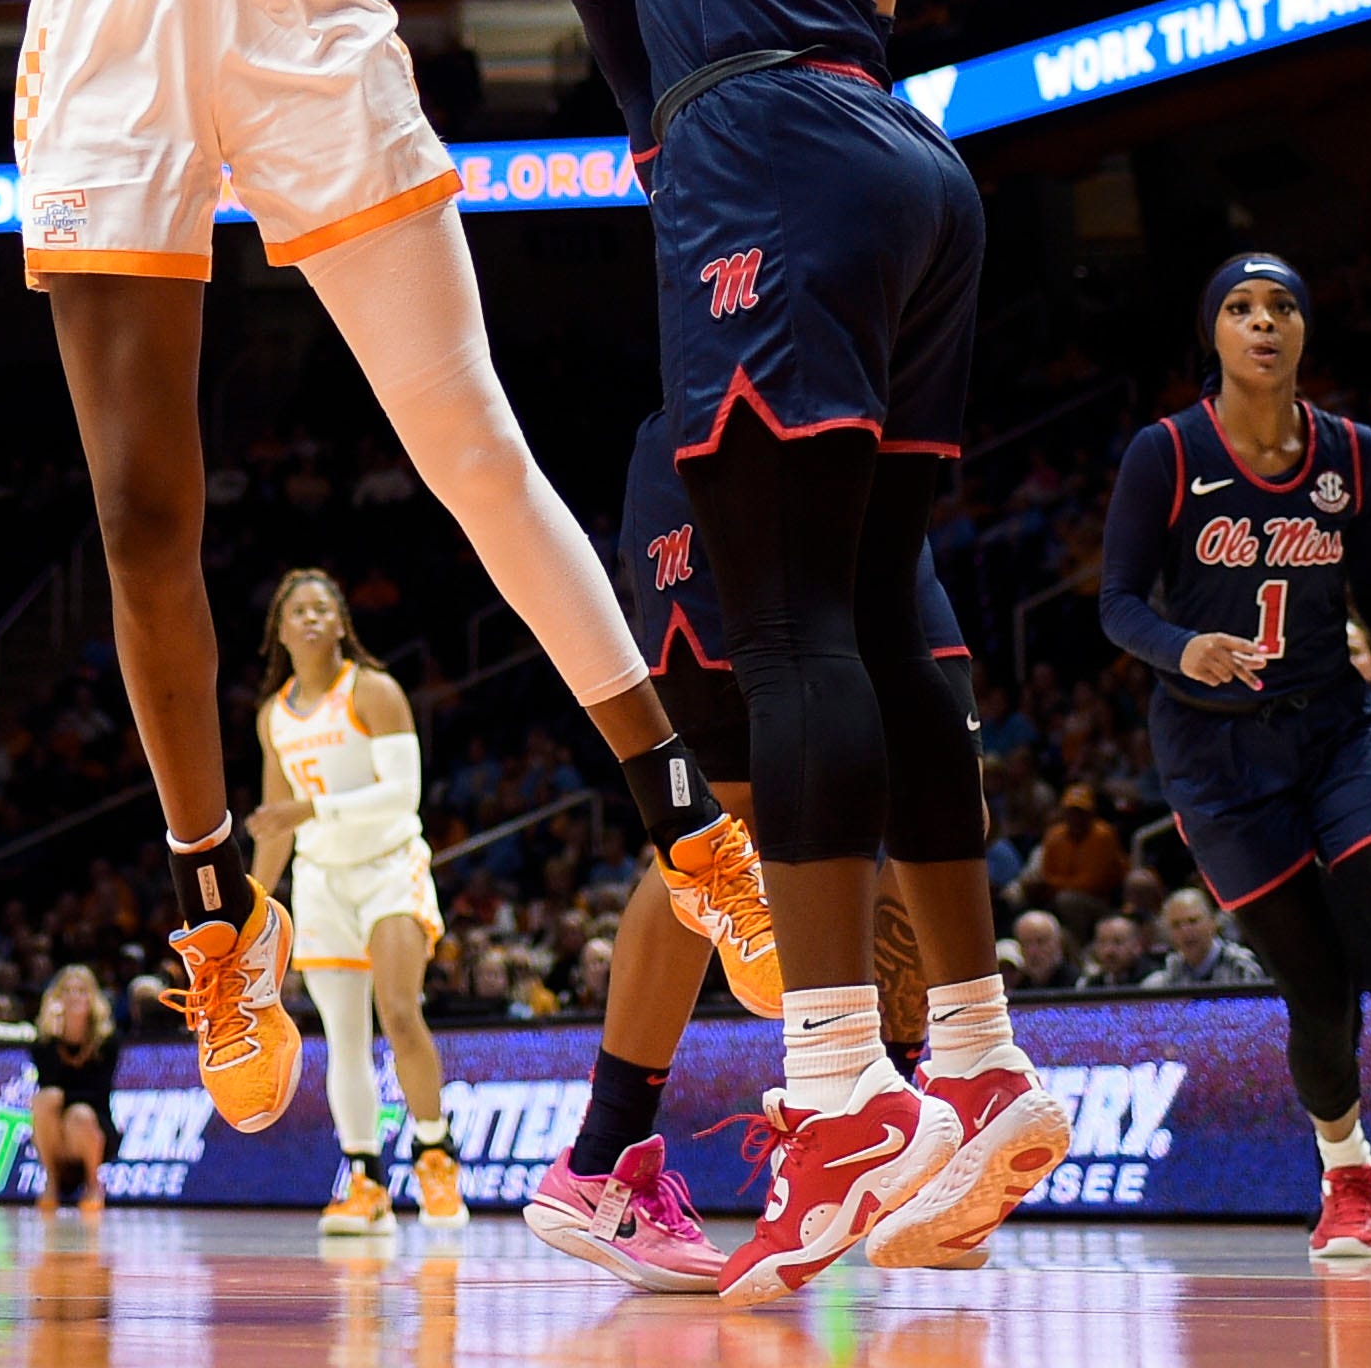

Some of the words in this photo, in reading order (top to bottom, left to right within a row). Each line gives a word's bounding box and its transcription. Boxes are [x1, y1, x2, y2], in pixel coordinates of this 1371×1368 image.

[1034, 22, 1155, 100] WORK
[700, 248, 763, 319] M
[647, 523, 694, 591] M
[1196, 516, 1260, 568] Ole
[1263, 517, 1344, 568] Miss
[1253, 579, 1289, 650] 1
